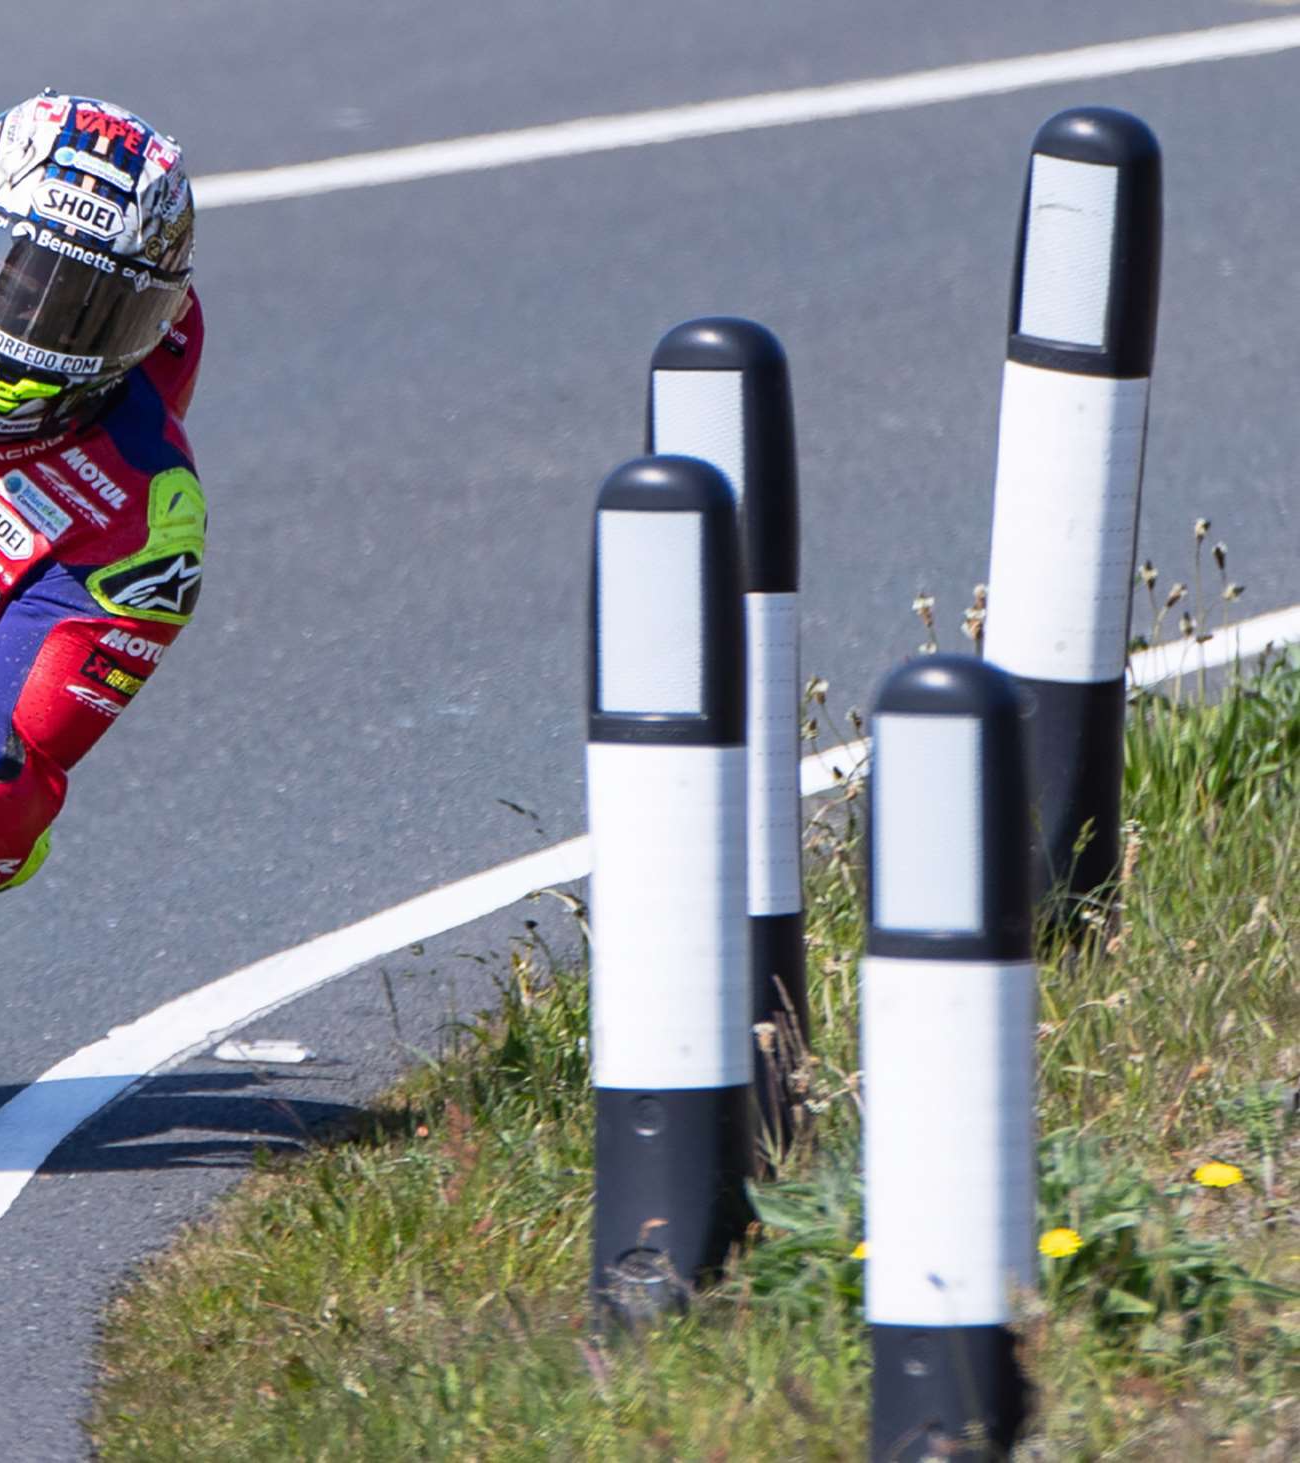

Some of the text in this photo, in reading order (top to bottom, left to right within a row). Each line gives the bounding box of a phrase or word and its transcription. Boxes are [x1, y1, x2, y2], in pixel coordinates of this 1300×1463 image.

[75, 109, 145, 155] VAPE
[43, 188, 116, 233] SHOEI
[36, 230, 117, 274] Bennetts
[61, 447, 129, 510] MOTUL
